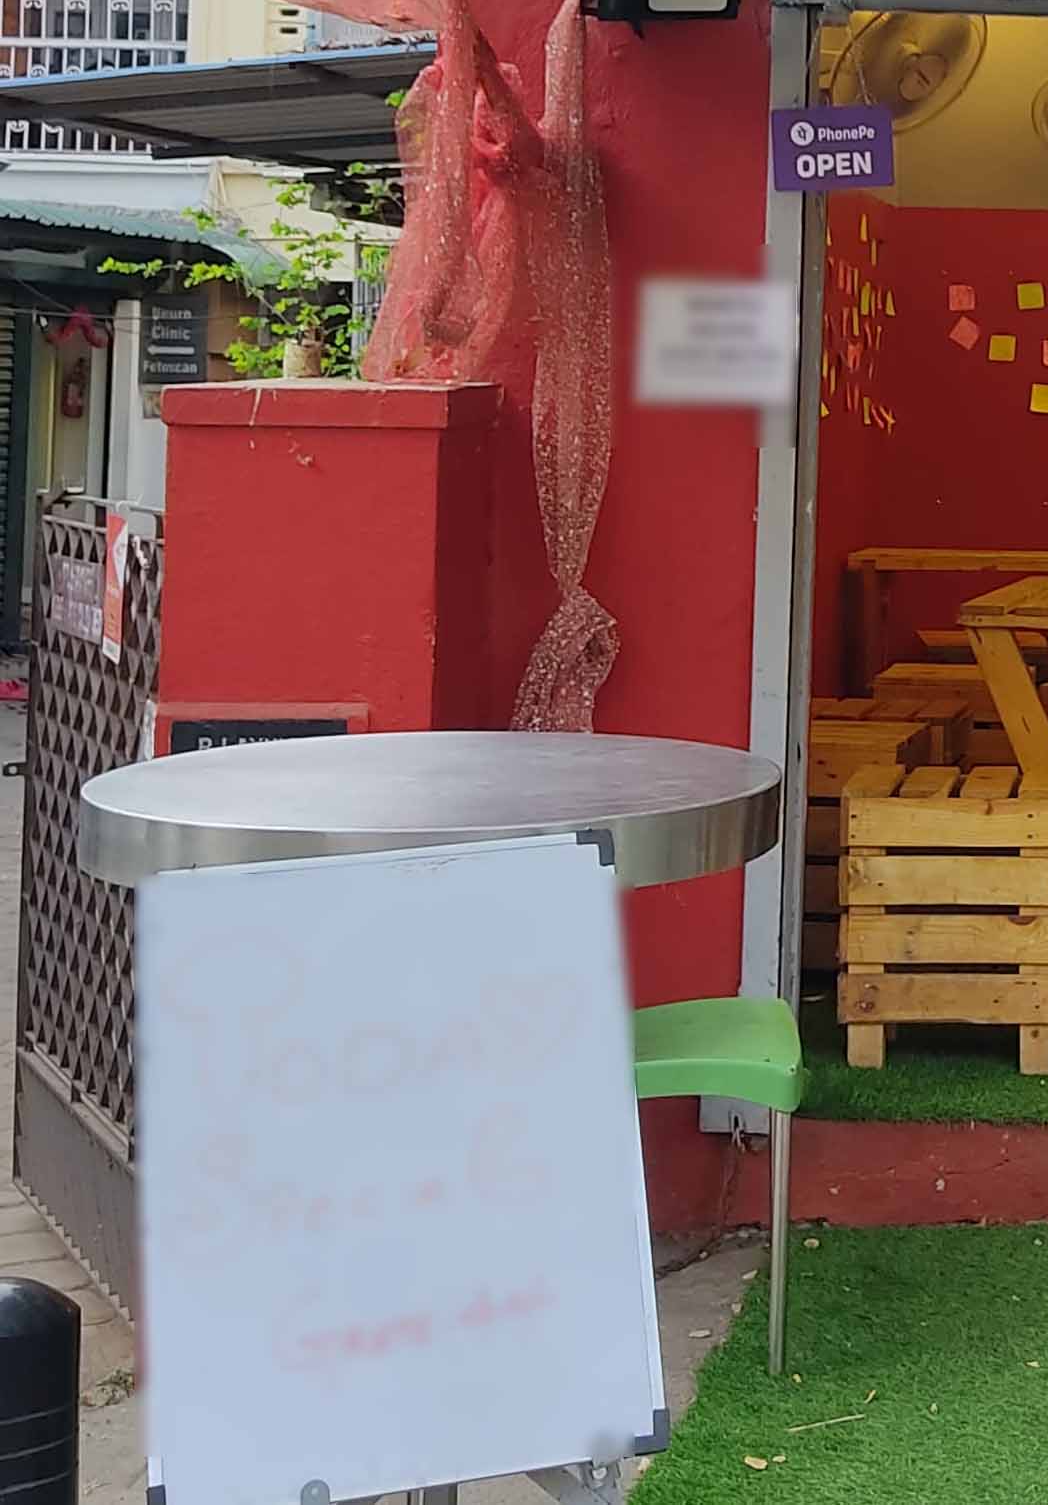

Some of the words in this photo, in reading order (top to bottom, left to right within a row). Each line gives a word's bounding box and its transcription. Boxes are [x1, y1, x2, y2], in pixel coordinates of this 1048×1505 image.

[817, 125, 876, 142] PhonePe
[796, 151, 873, 179] OPEN
[151, 324, 192, 341] Clinic
